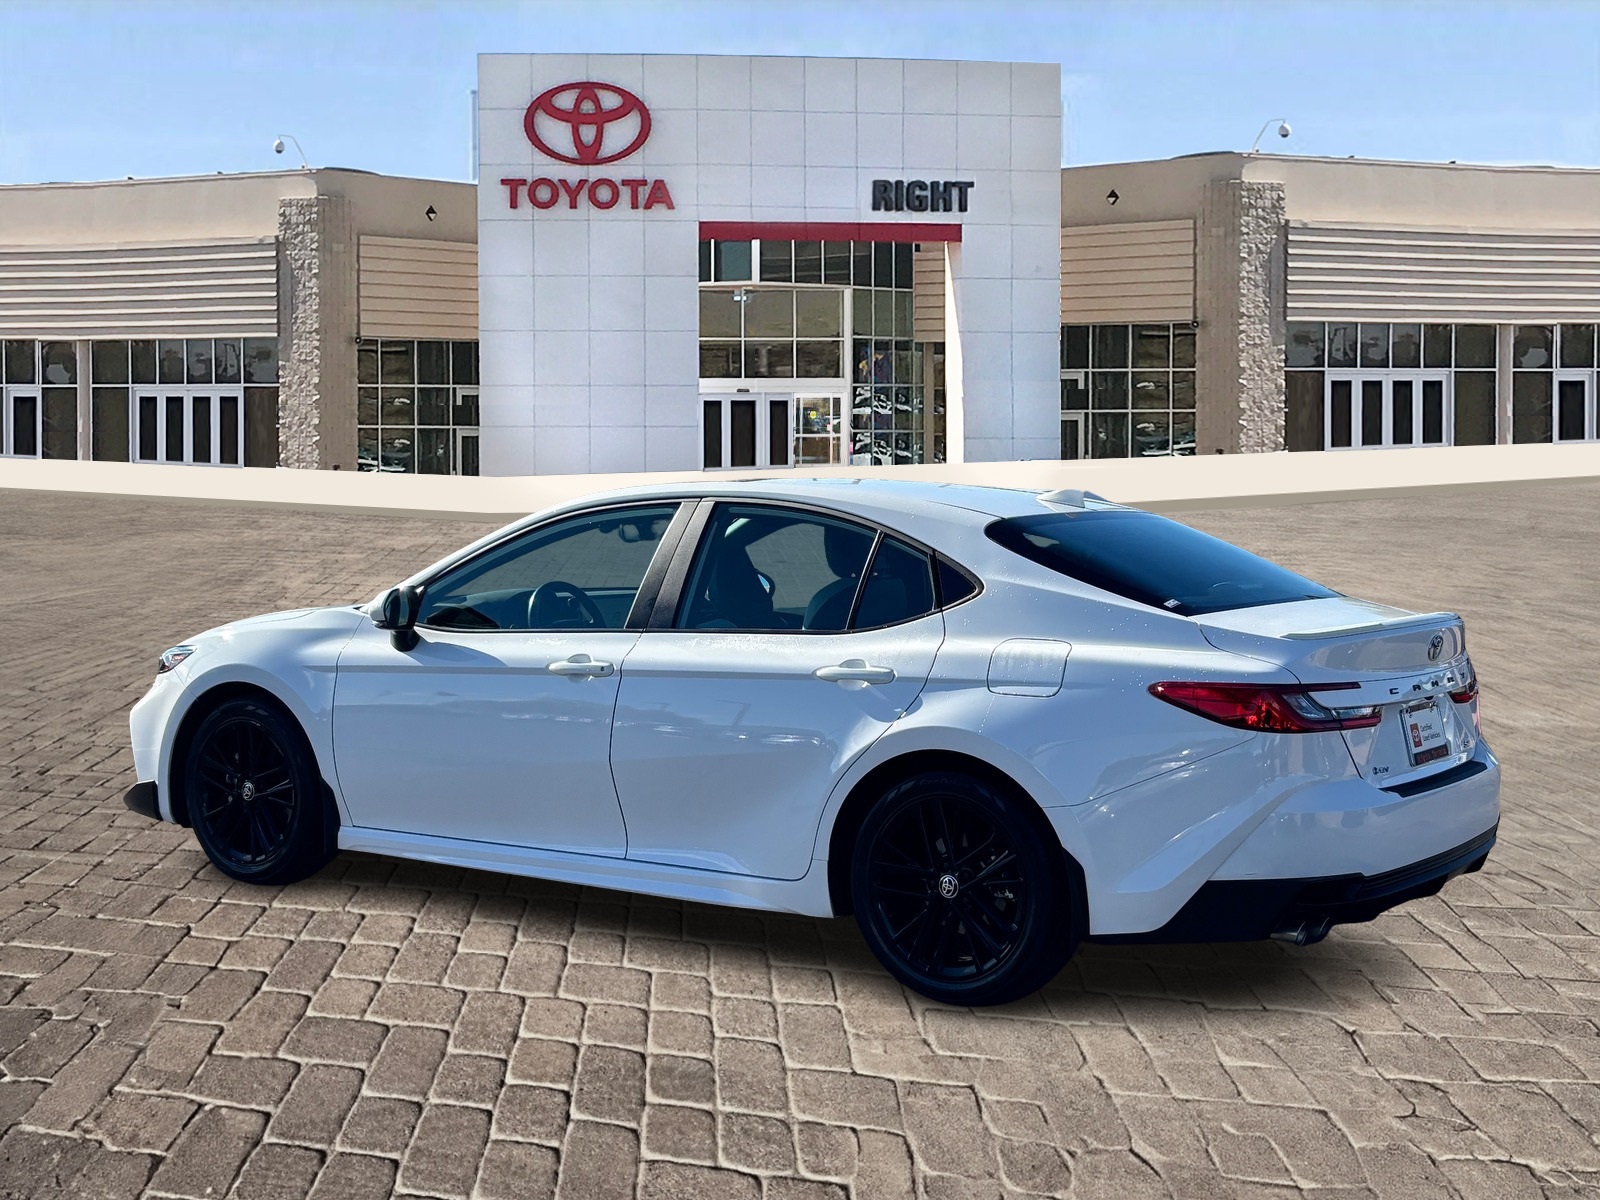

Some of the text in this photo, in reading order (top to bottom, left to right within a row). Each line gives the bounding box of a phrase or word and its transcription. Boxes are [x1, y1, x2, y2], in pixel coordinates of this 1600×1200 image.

[500, 178, 675, 210] TOYOTA
[871, 179, 974, 212] RIGHT
[1389, 672, 1466, 695] CAMRY
